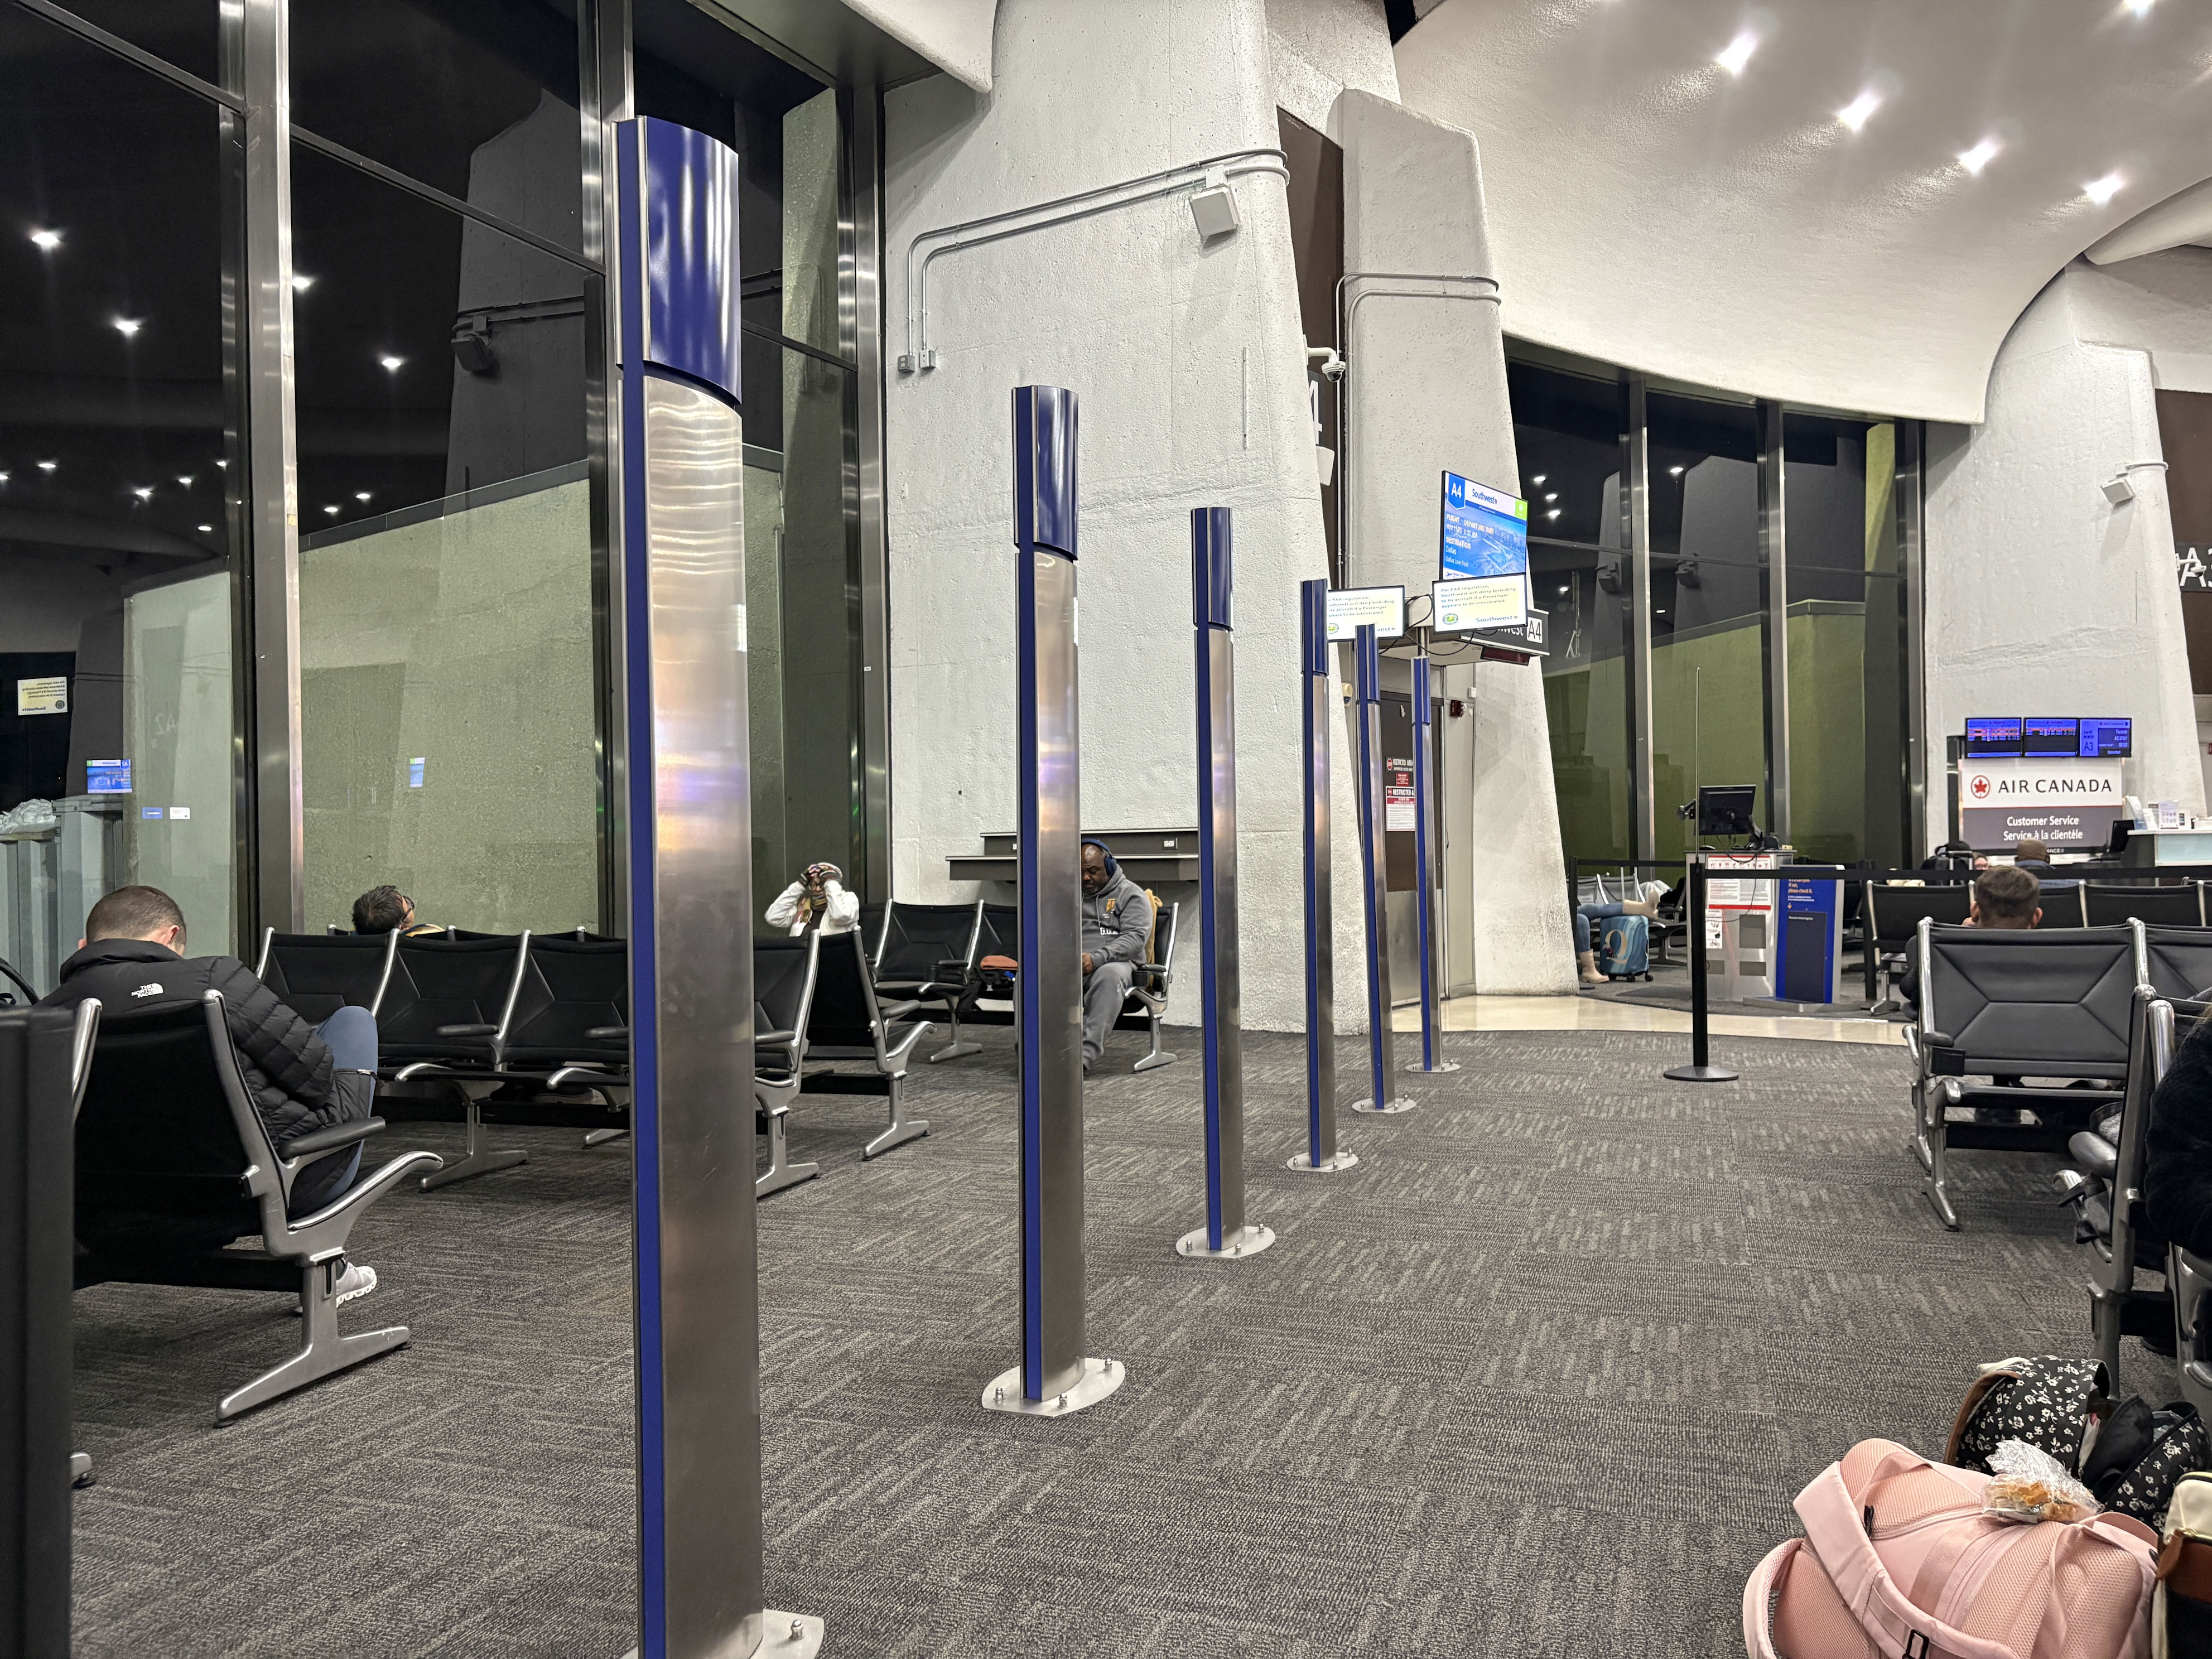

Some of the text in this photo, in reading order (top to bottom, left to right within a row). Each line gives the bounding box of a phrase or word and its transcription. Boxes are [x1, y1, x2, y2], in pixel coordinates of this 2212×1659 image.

[1451, 483, 1462, 498] A4
[1472, 489, 1495, 504] Southwest
[1447, 514, 1494, 535] FLIGHT DEPARTURE TIME
[1445, 545, 1457, 555] Dallas
[1446, 537, 1471, 549] DESTINATION
[2180, 547, 2212, 588] A
[1527, 620, 1541, 641] A4
[2084, 742, 2094, 751] A3
[1998, 779, 2112, 793] AIR CANADA
[2006, 815, 2079, 826] Customer Service
[2003, 828, 2083, 841] Service à la clientèle
[1604, 929, 1629, 964] Q
